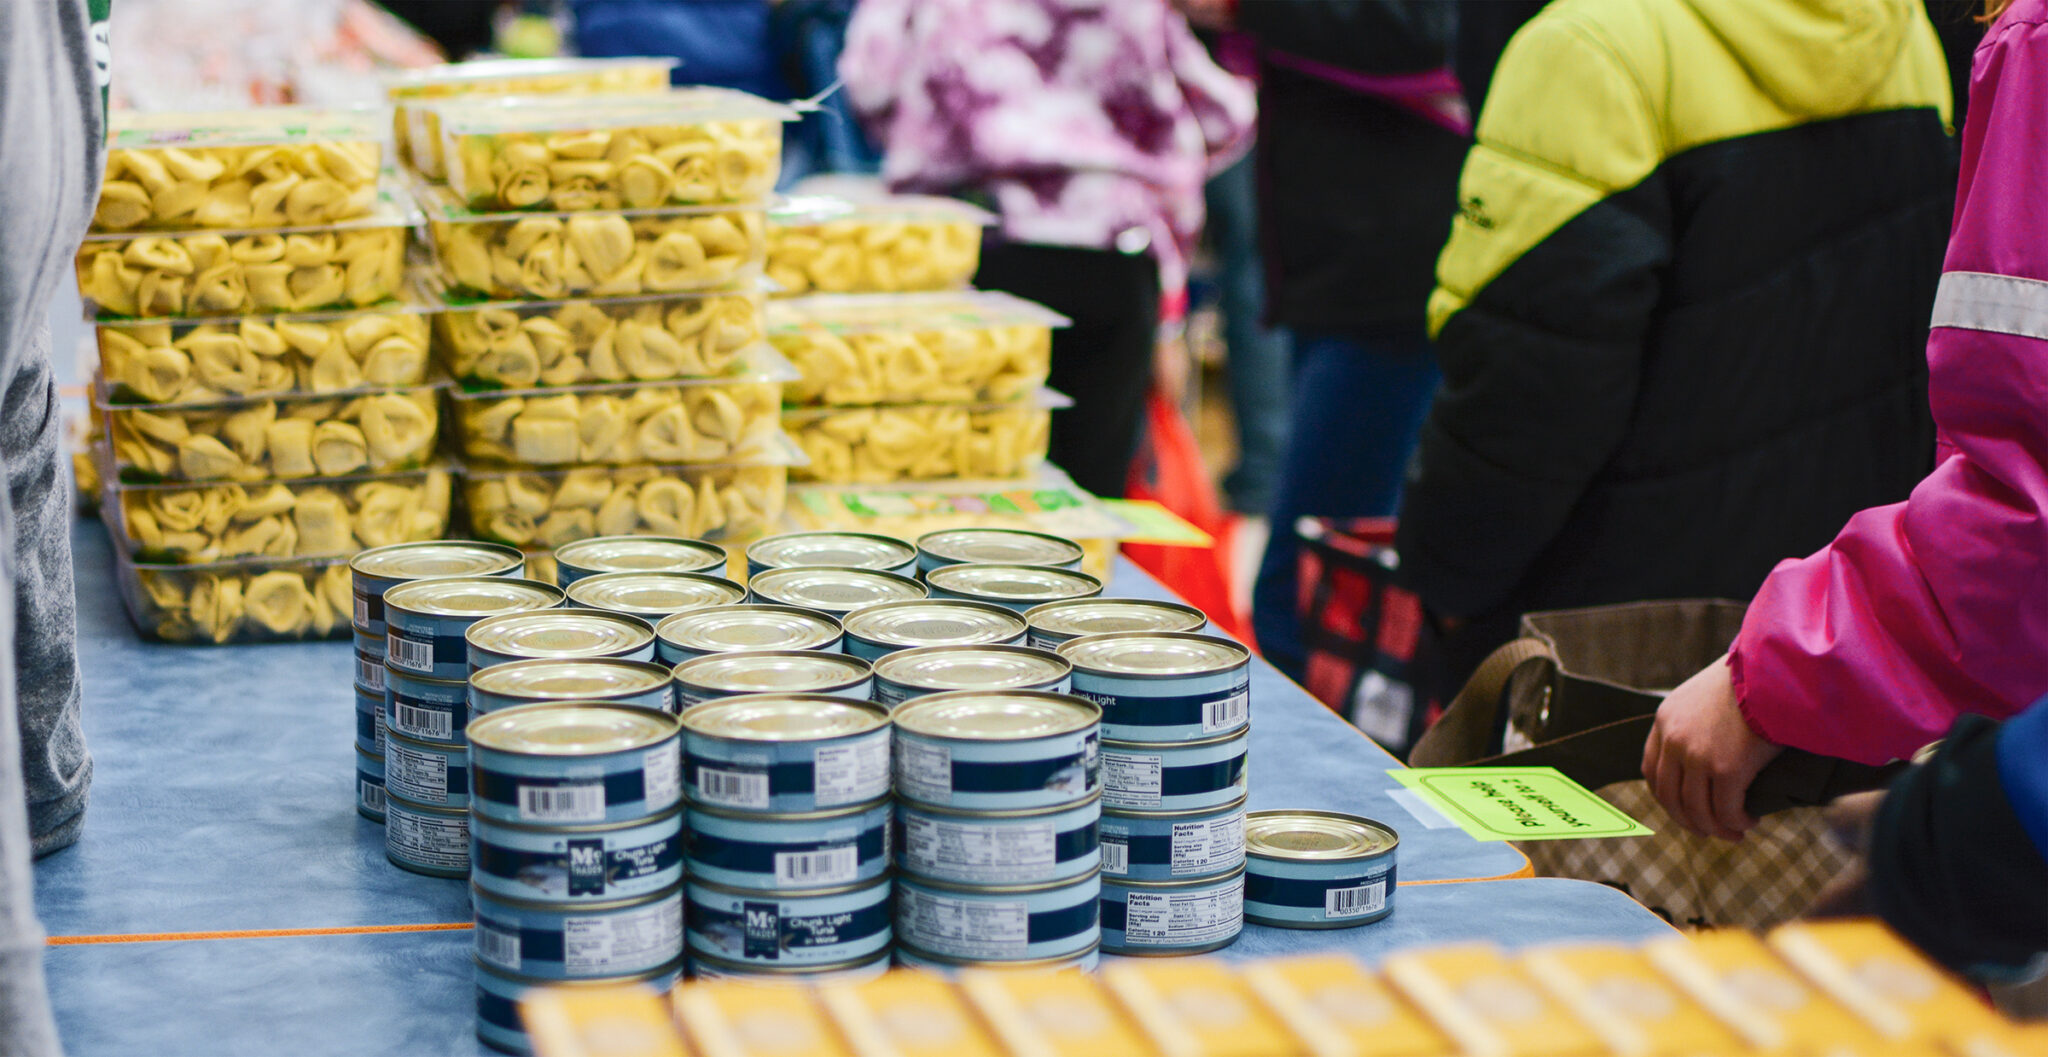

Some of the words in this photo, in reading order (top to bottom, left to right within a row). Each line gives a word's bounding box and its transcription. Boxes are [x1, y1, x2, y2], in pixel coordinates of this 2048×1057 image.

[1470, 780, 1505, 798] help
[1496, 799, 1545, 827] Please
[789, 917, 824, 929] Chunk
[826, 913, 853, 926] Light
[811, 925, 836, 936] Tuna
